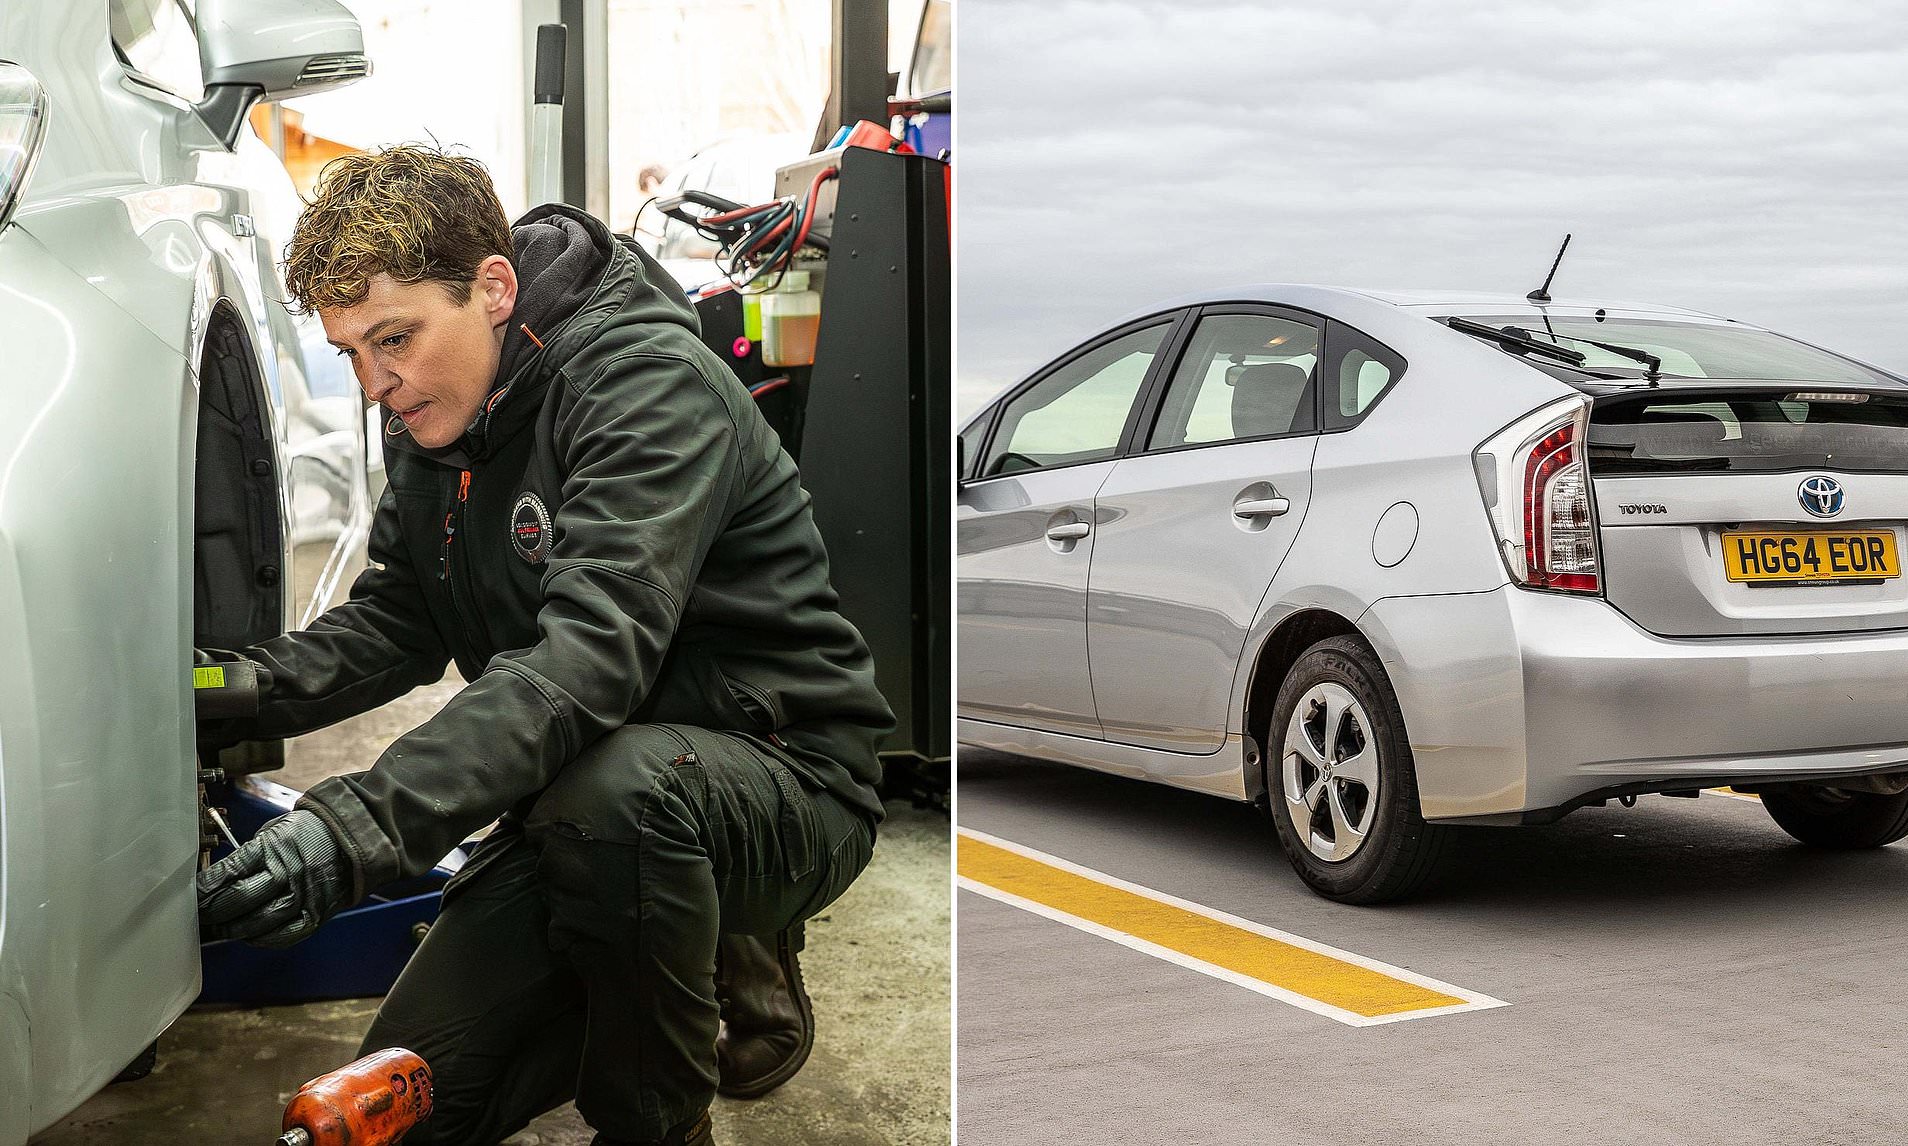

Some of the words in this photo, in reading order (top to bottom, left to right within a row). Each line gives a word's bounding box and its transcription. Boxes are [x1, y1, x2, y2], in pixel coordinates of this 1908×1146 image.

[1618, 503, 1668, 515] TOYOTA
[1737, 537, 1821, 574] HG64
[1828, 537, 1888, 572] EOR
